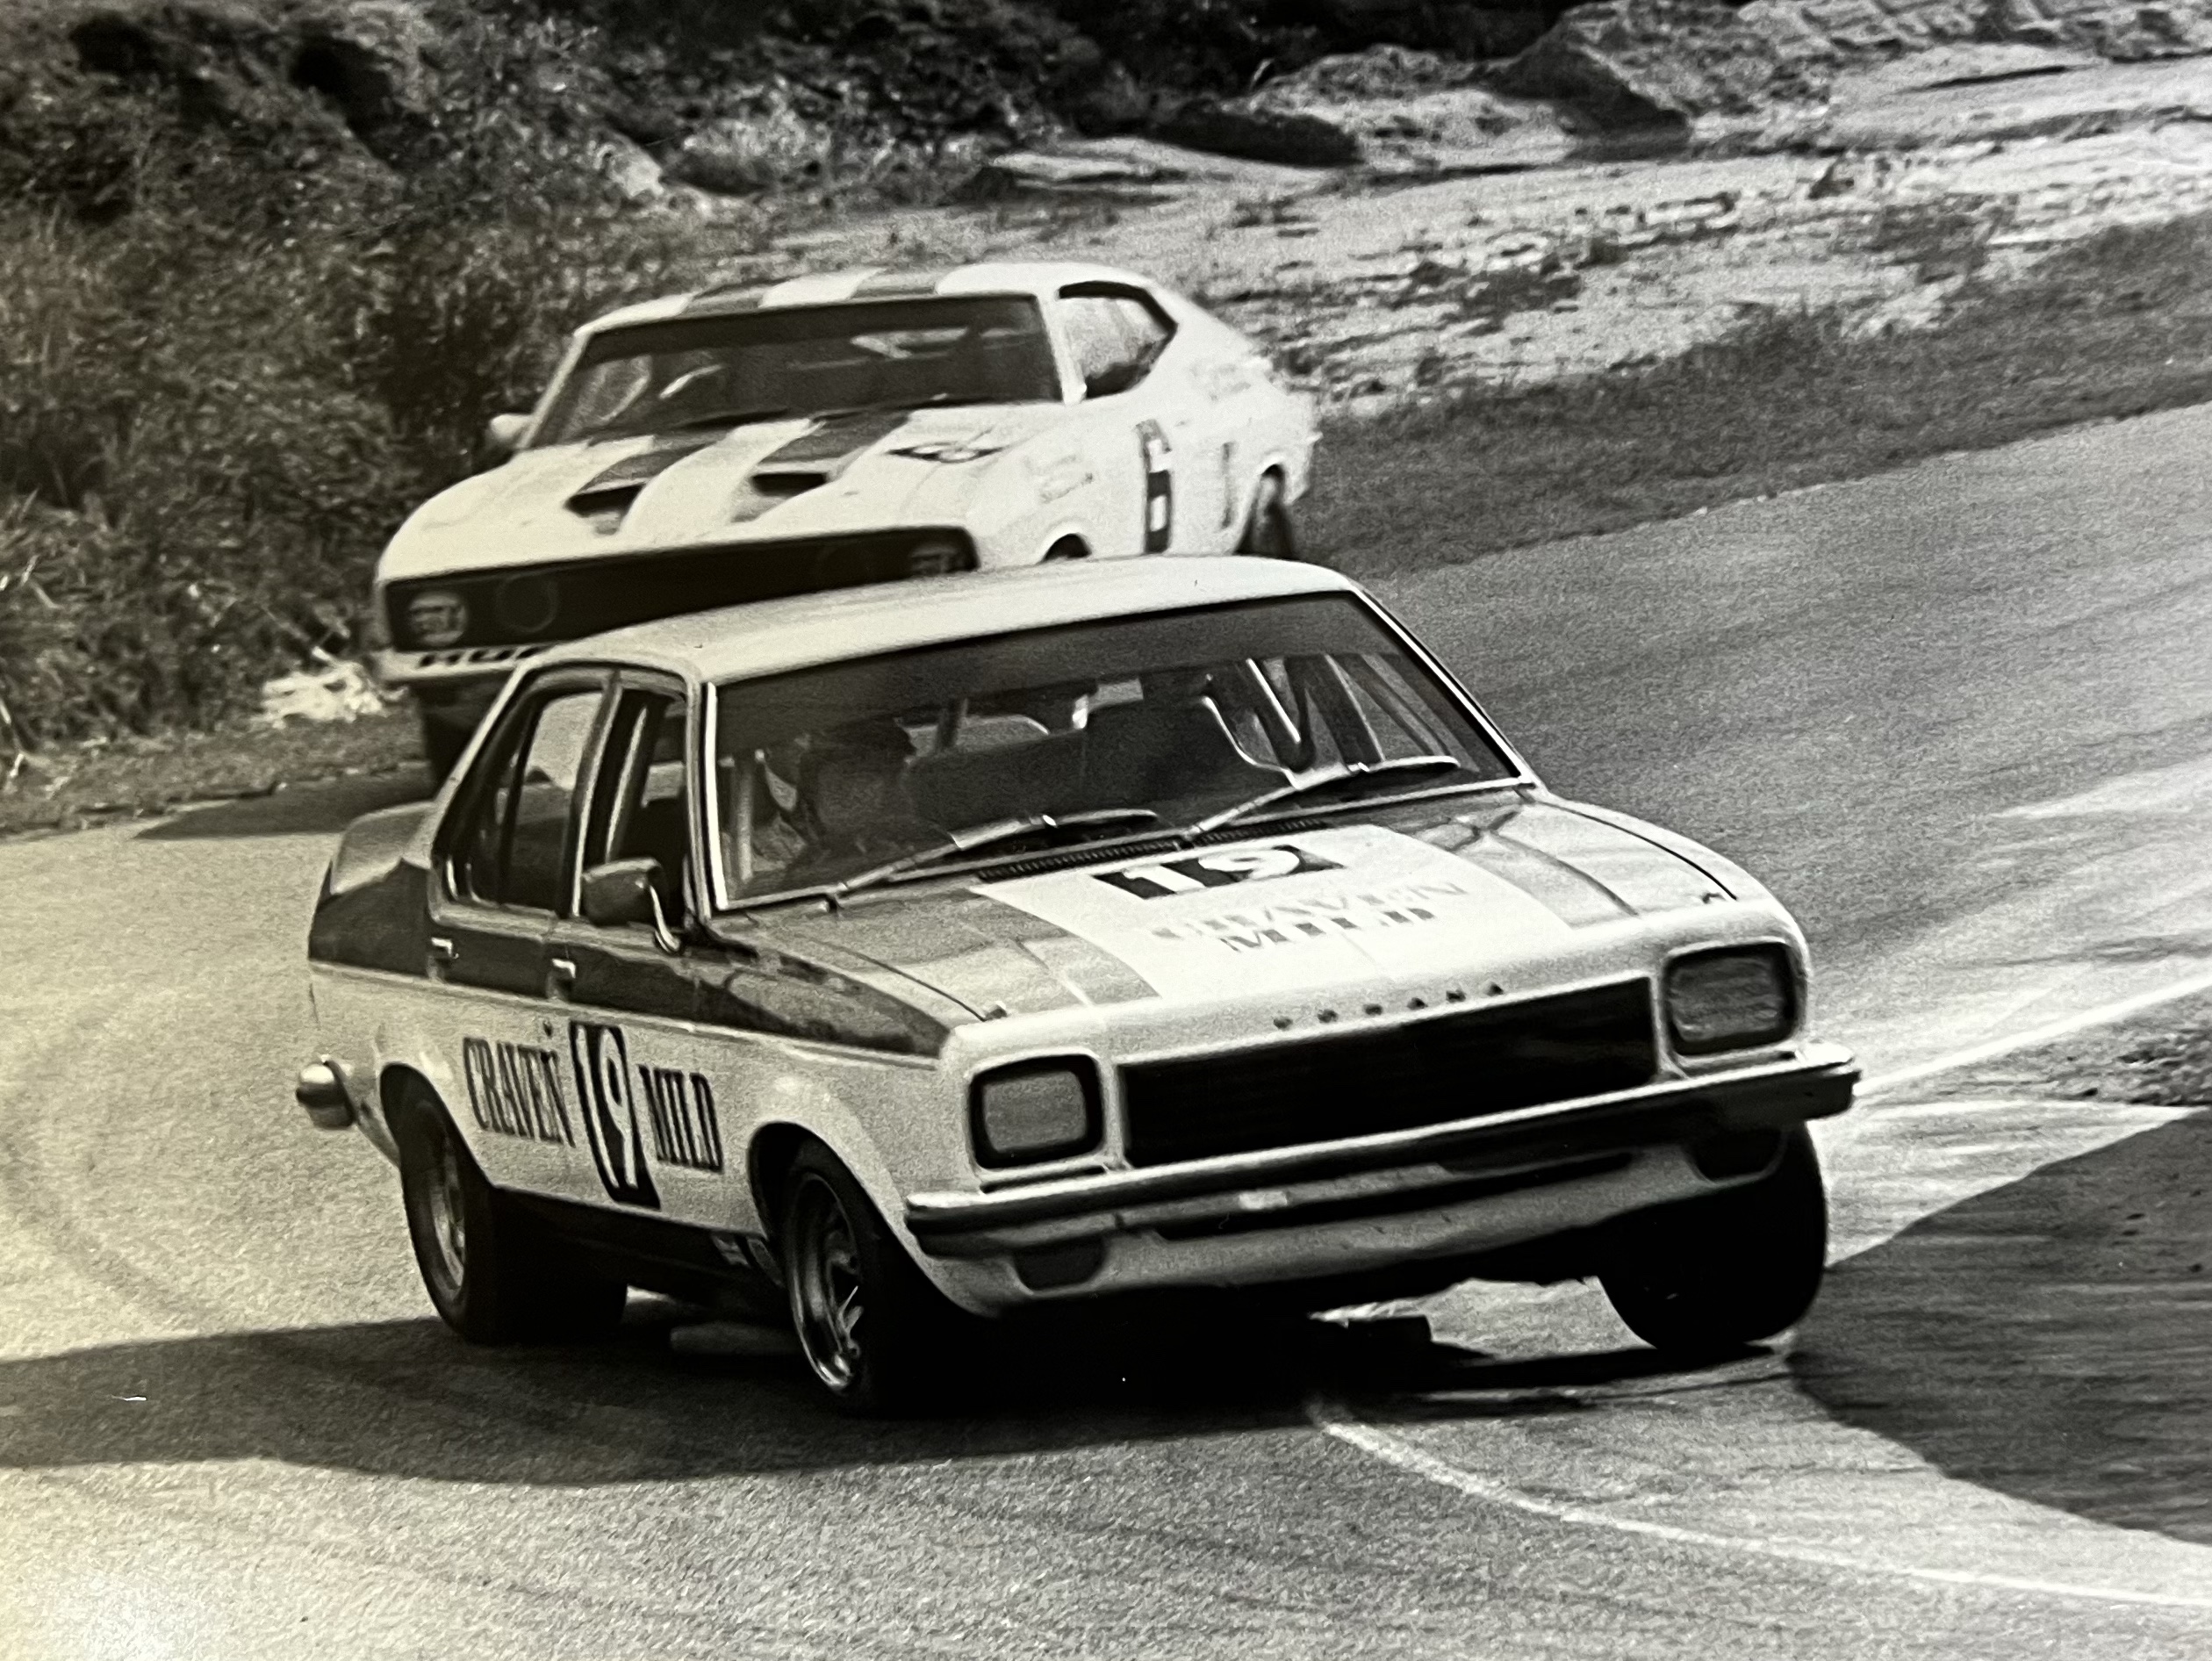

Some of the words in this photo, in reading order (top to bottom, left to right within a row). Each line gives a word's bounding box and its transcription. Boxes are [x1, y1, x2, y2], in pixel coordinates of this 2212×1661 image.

[1110, 845, 1312, 897] 19
[1219, 907, 1435, 952] MILD
[463, 1036, 576, 1148] CRAVEN
[571, 1022, 648, 1196] 19
[638, 1063, 724, 1174] MILD
